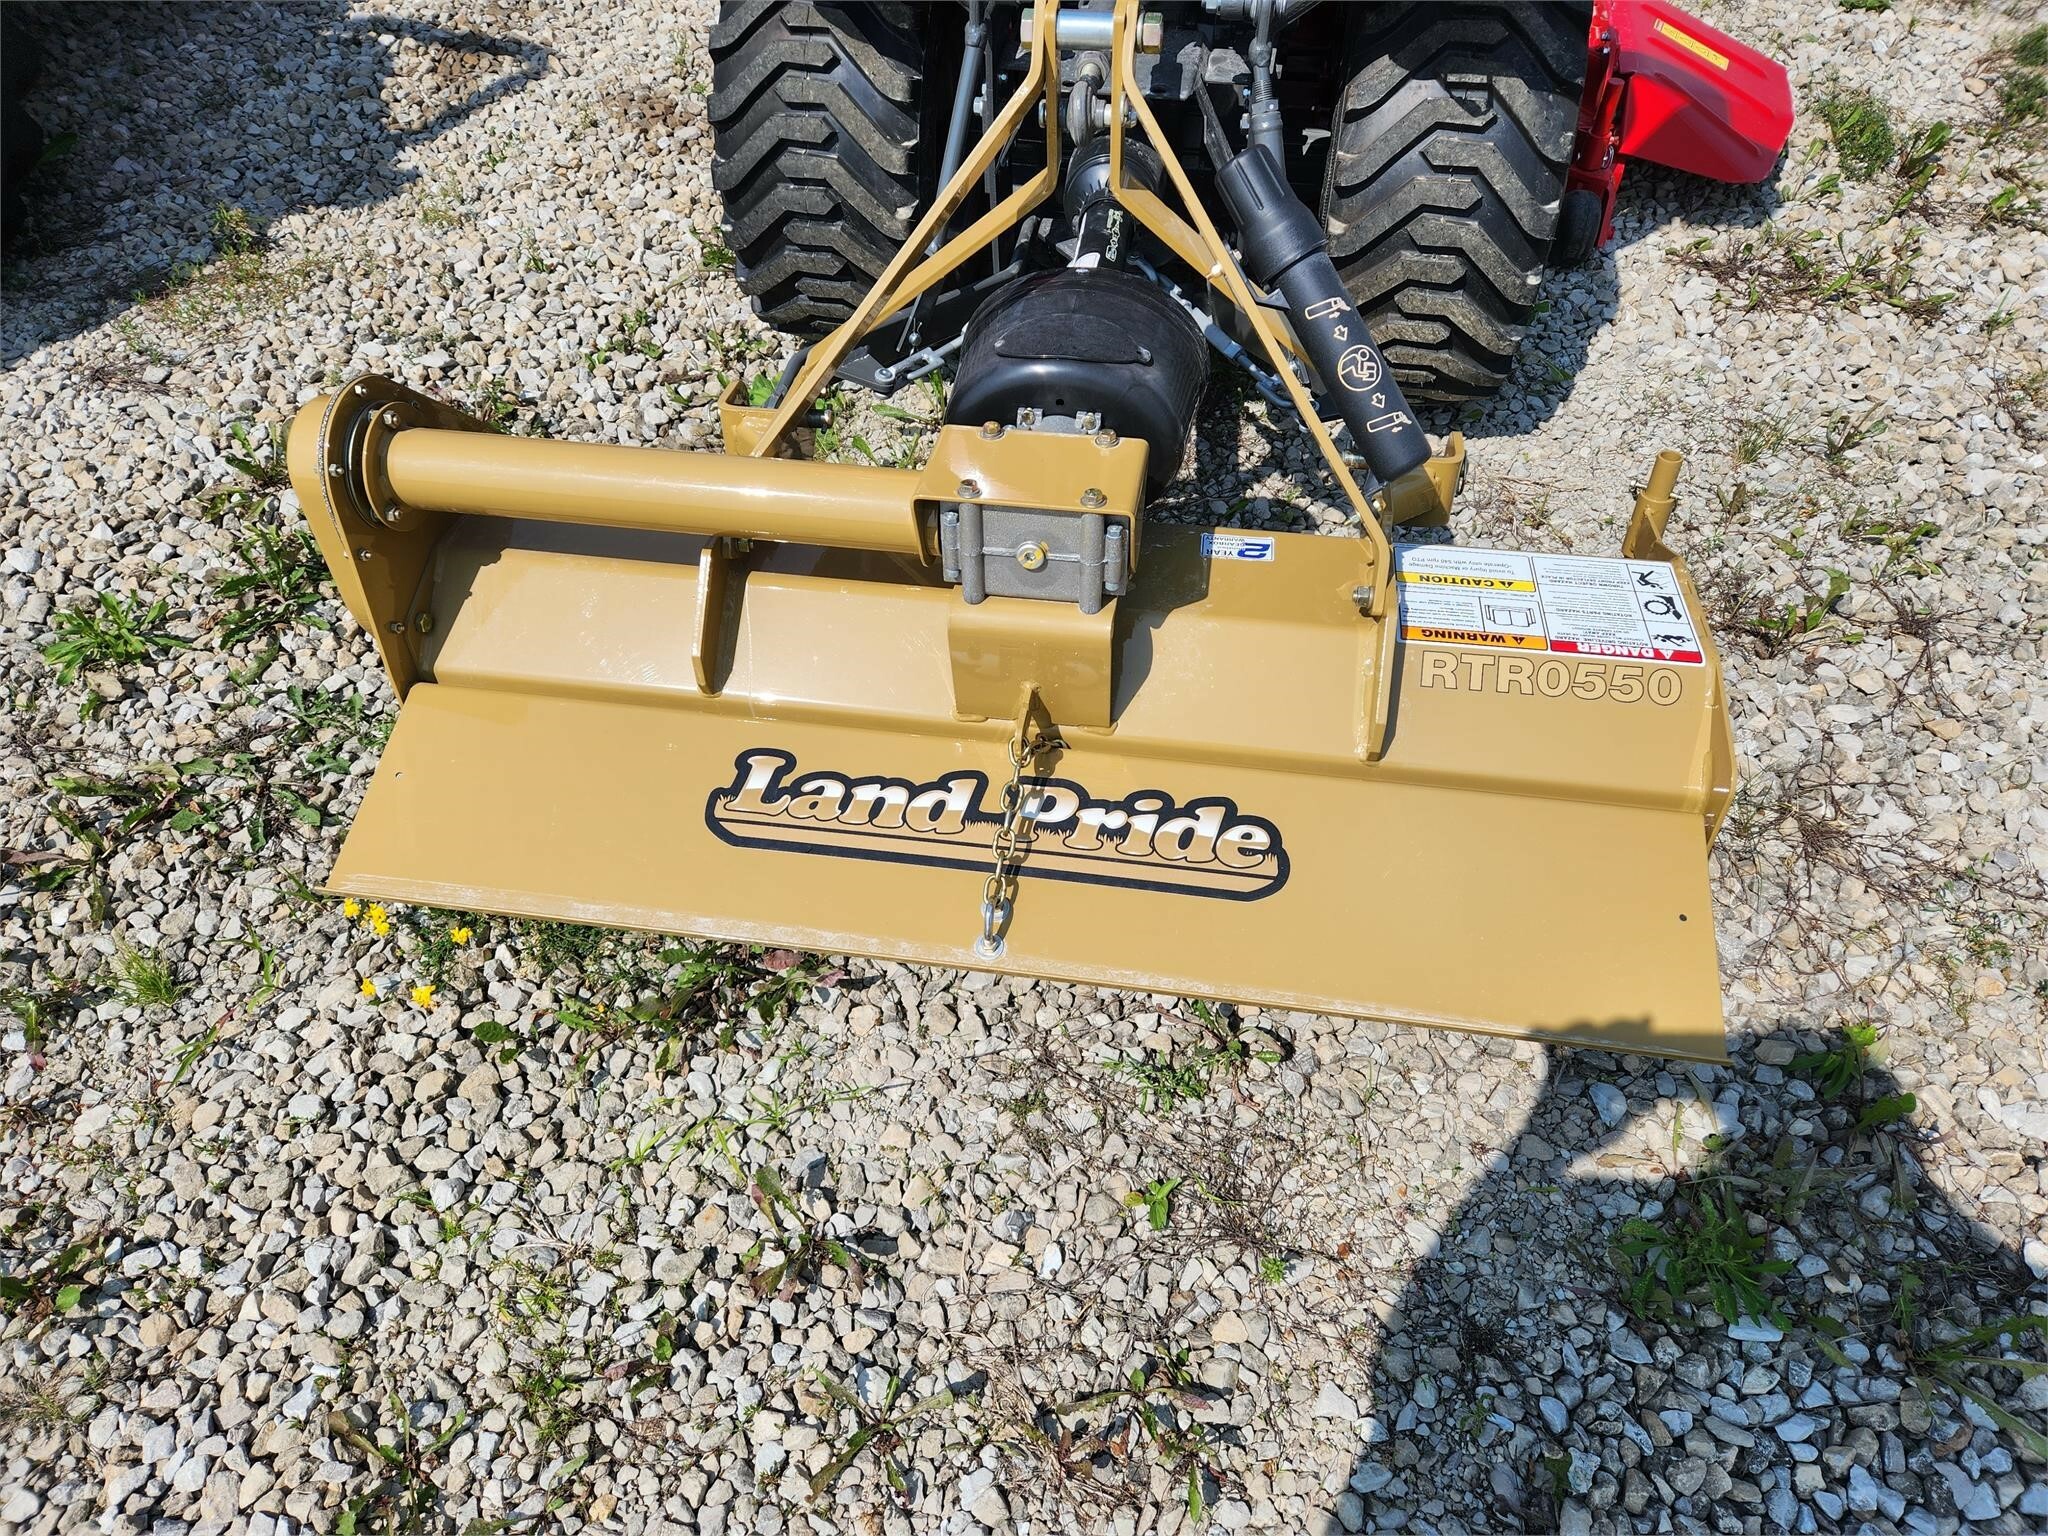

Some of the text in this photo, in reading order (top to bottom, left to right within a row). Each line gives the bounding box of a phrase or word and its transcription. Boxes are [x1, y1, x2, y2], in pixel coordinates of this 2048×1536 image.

[1206, 542, 1270, 559] 2 YEAR
[1419, 575, 1494, 587] CAUTION
[1421, 629, 1506, 644] WARNING
[1576, 642, 1654, 658] DANGER
[1420, 651, 1683, 706] RTR0550
[724, 755, 1273, 869] Land Pride
